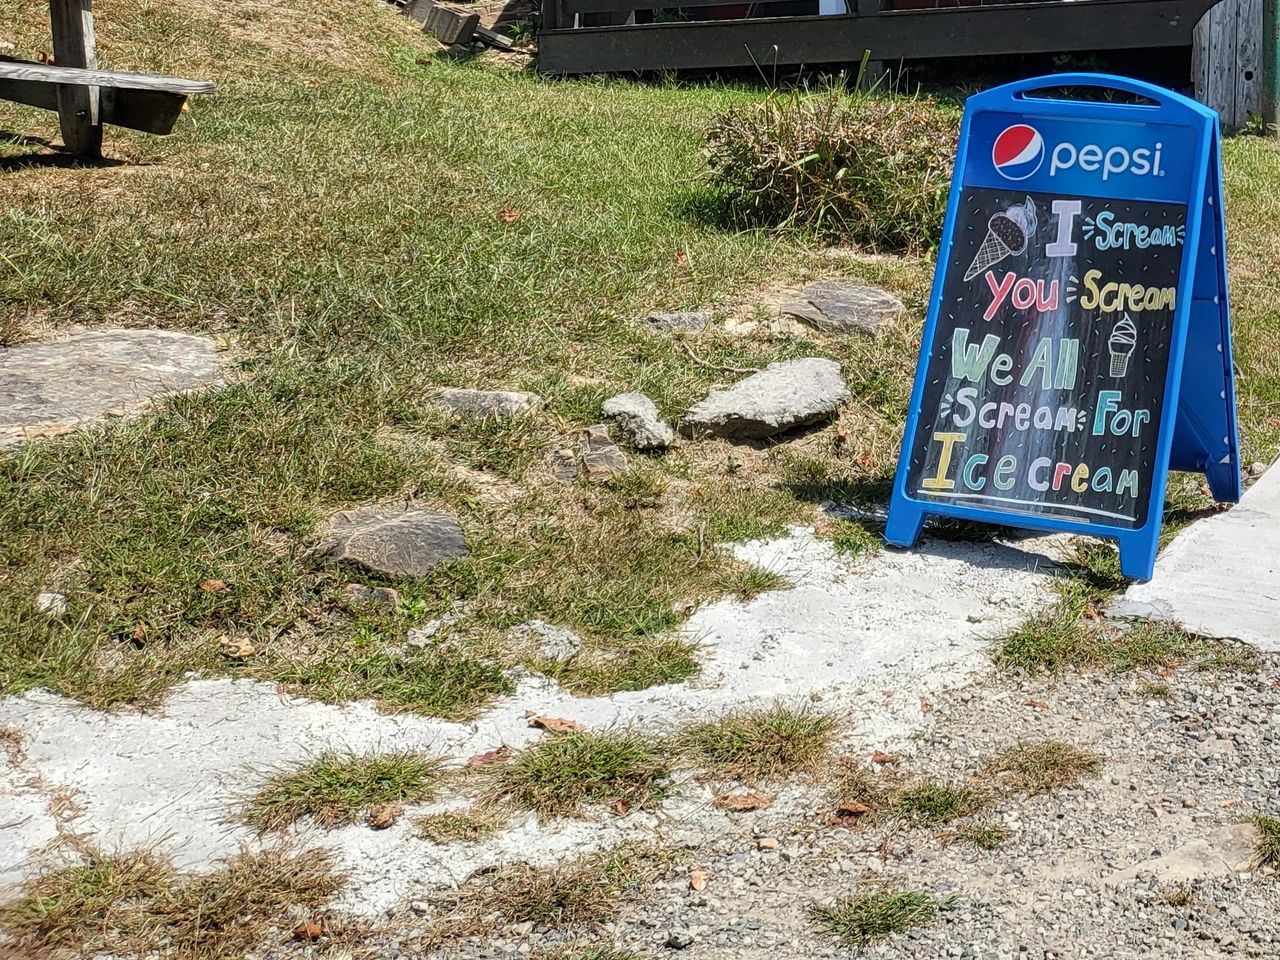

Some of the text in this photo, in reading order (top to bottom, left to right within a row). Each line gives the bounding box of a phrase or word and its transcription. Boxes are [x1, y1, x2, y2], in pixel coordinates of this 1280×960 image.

[1049, 142, 1163, 181] pepsi
[1045, 200, 1176, 257] I Scream
[983, 269, 1176, 322] You Scream
[951, 327, 1080, 390] We All
[952, 387, 1151, 438] Scream For
[921, 431, 1140, 498] Ice cream
